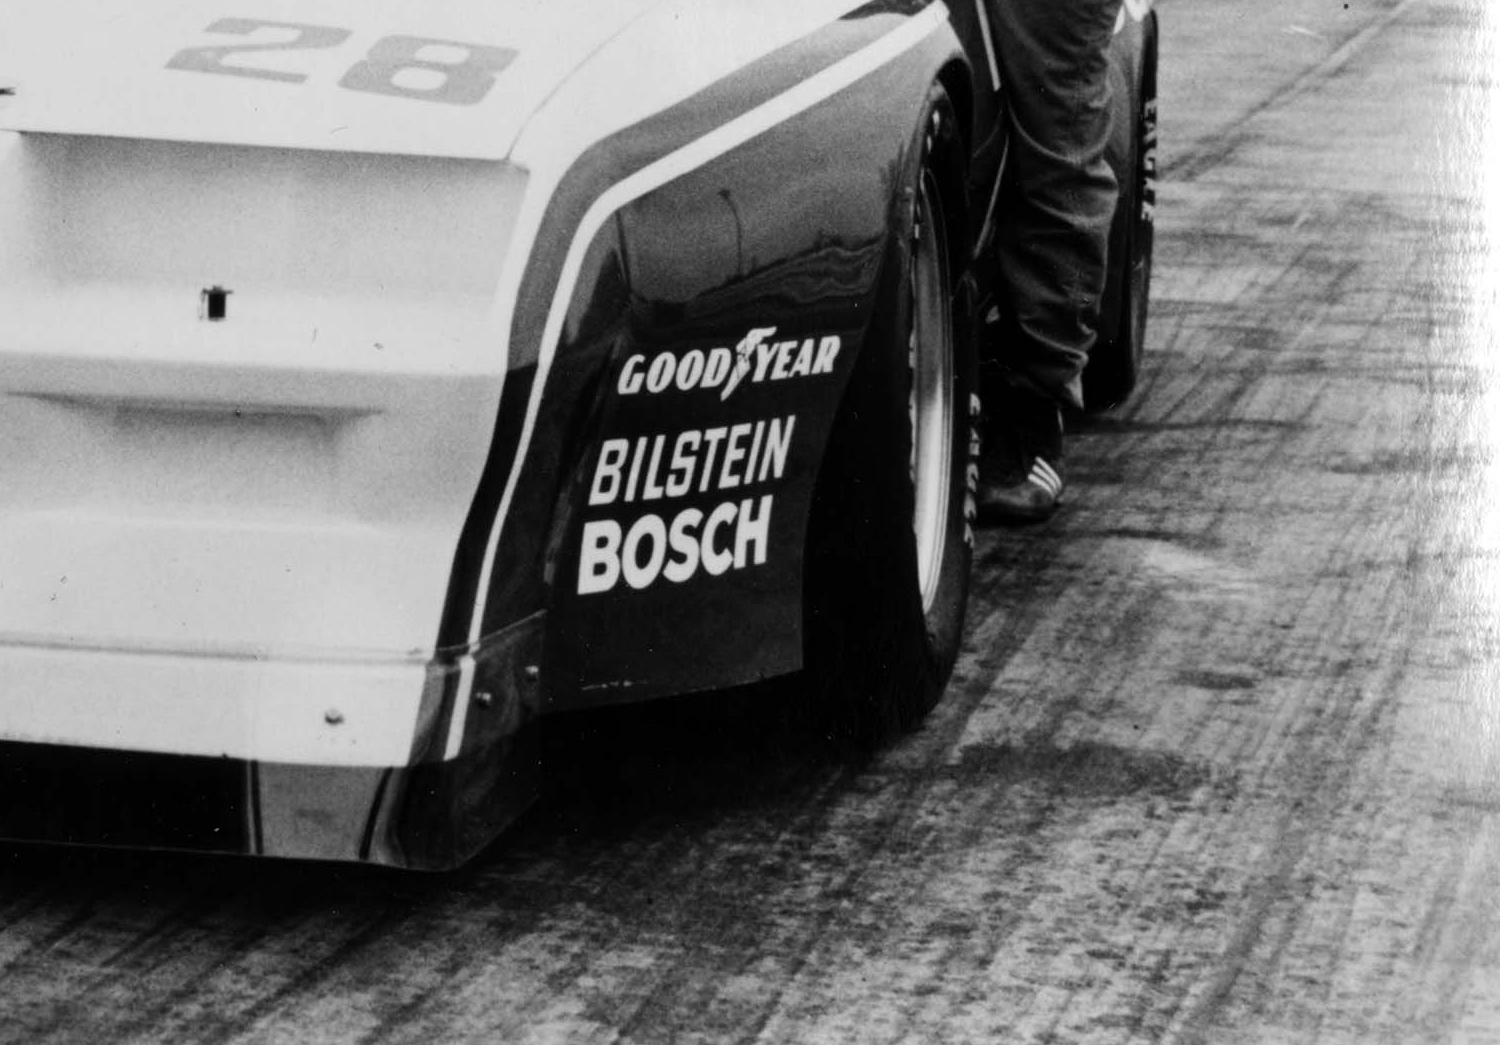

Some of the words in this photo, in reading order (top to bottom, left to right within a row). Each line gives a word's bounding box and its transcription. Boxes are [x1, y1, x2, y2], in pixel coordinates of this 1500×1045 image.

[163, 16, 521, 106] 28
[616, 325, 842, 402] GOODYEAR
[588, 414, 796, 506] BILSTEIN
[576, 493, 774, 596] BOSCH
